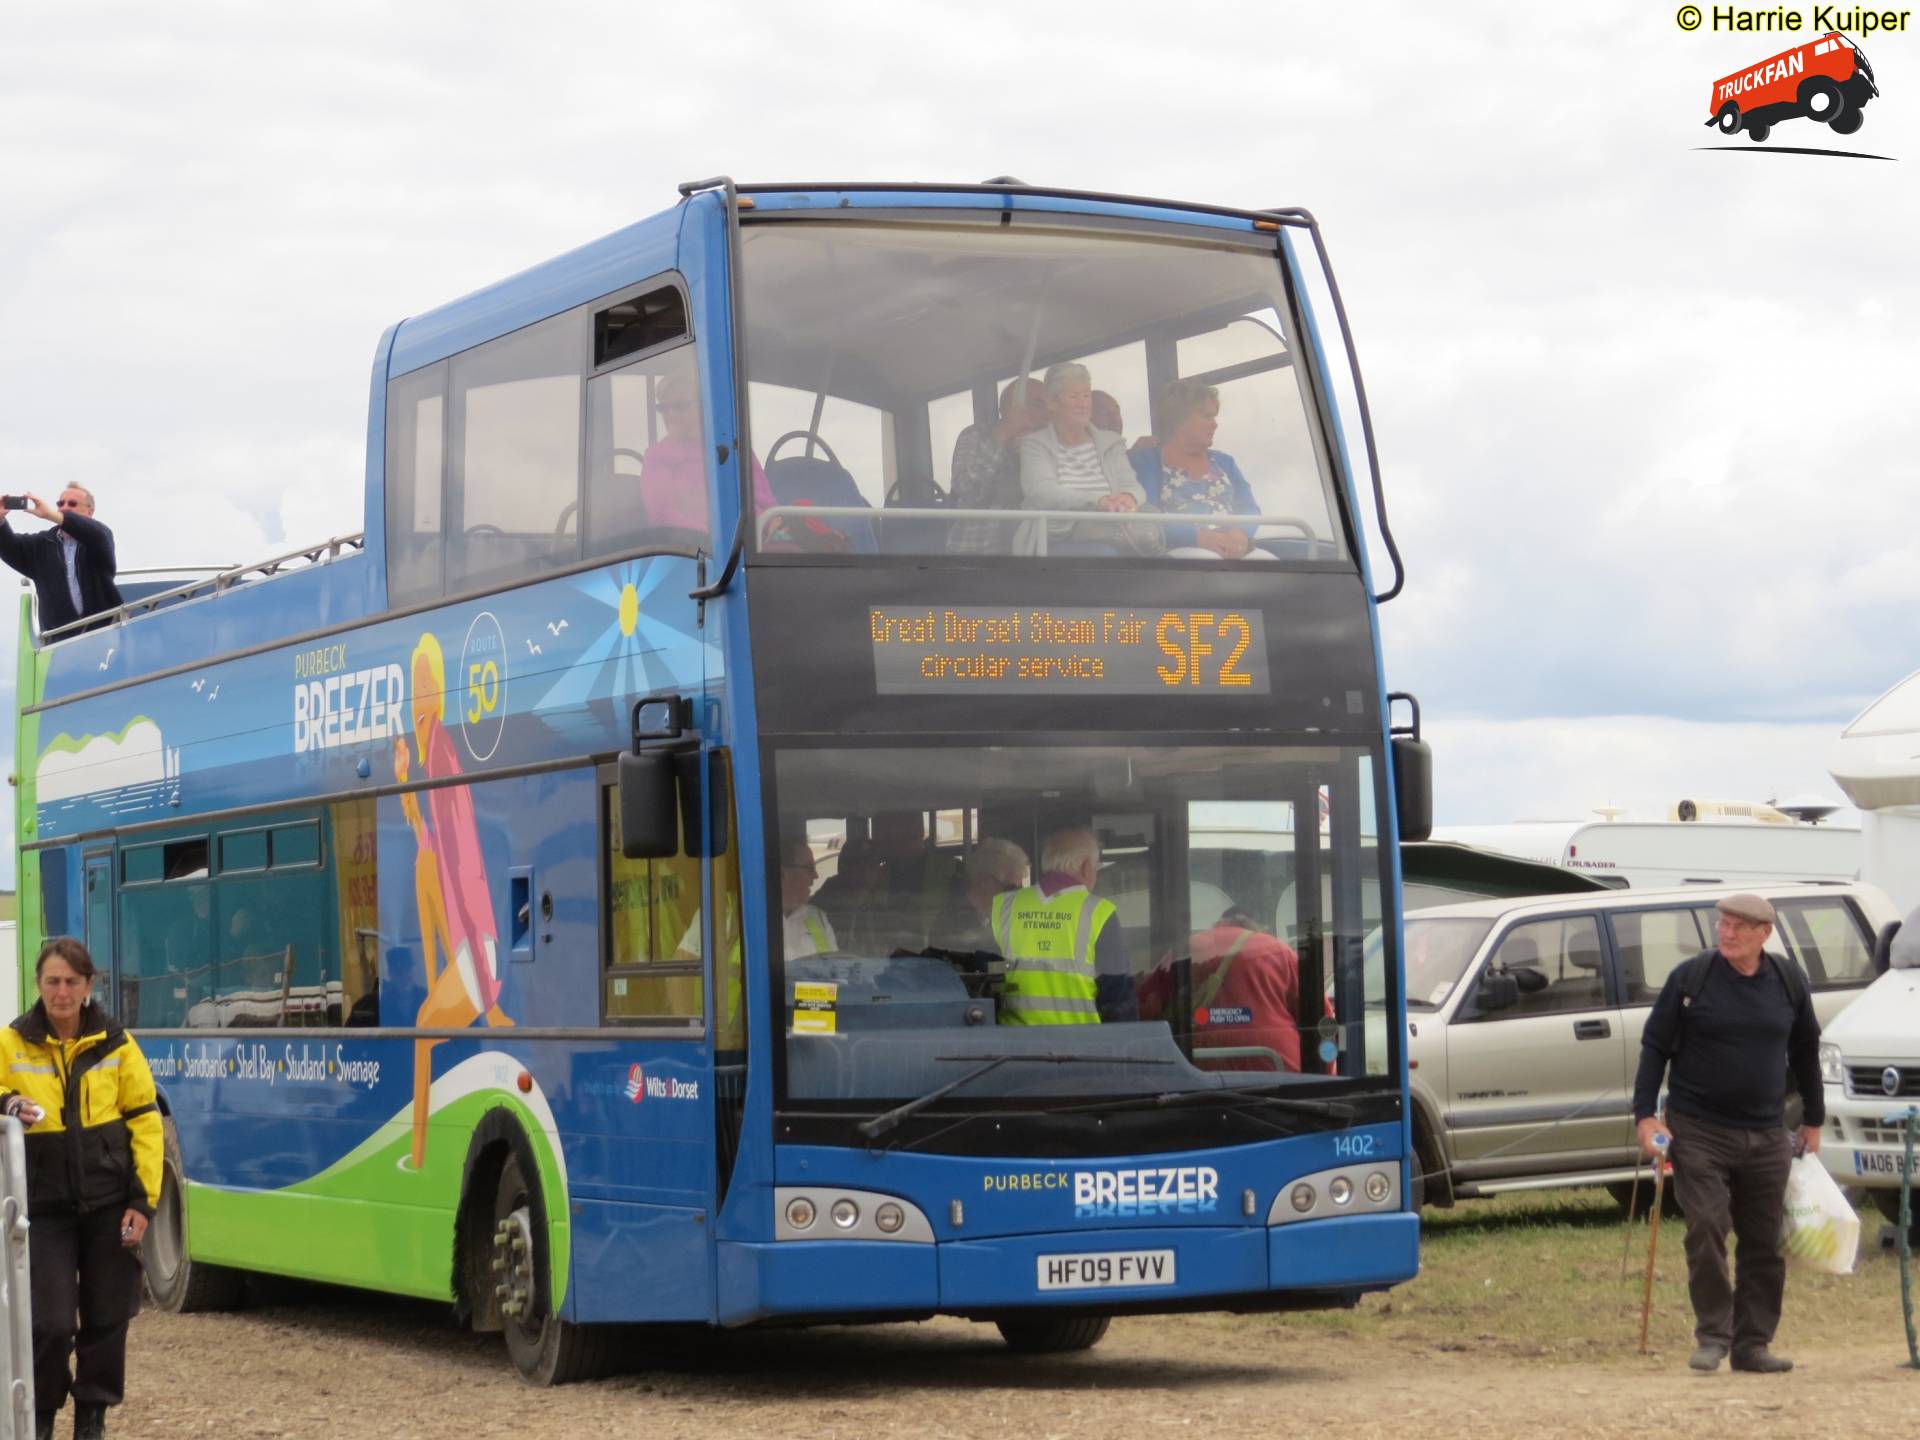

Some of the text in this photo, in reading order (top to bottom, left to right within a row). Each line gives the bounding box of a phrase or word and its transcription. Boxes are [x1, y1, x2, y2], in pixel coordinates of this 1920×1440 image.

[871, 611, 1147, 644] Great Dorset Steam Fair
[471, 634, 496, 653] ROUTE
[1156, 612, 1251, 686] SF2
[295, 644, 347, 679] PURBECK
[920, 654, 1104, 677] circular service
[467, 661, 498, 725] 50
[294, 663, 404, 753] BREEZER
[1567, 860, 1616, 869] CRUSADER
[1017, 911, 1072, 920] SHUTTLE BUS
[1023, 921, 1061, 929] STEWARD
[1037, 940, 1051, 951] 132
[1210, 1015, 1250, 1023] PUSH TO OPEN
[184, 1043, 228, 1077] Sandbanks
[237, 1043, 258, 1079] Shell
[259, 1045, 275, 1086] Bay
[285, 1044, 326, 1081] Studland
[336, 1044, 380, 1089] Swanage
[646, 1077, 666, 1097] Wilts
[672, 1078, 698, 1099] Dorset
[1333, 1135, 1374, 1156] 1402
[1861, 1152, 1894, 1173] WA06
[984, 1166, 1218, 1206] PURBECK BREEZER
[1048, 1255, 1165, 1285] HF09 FVV
